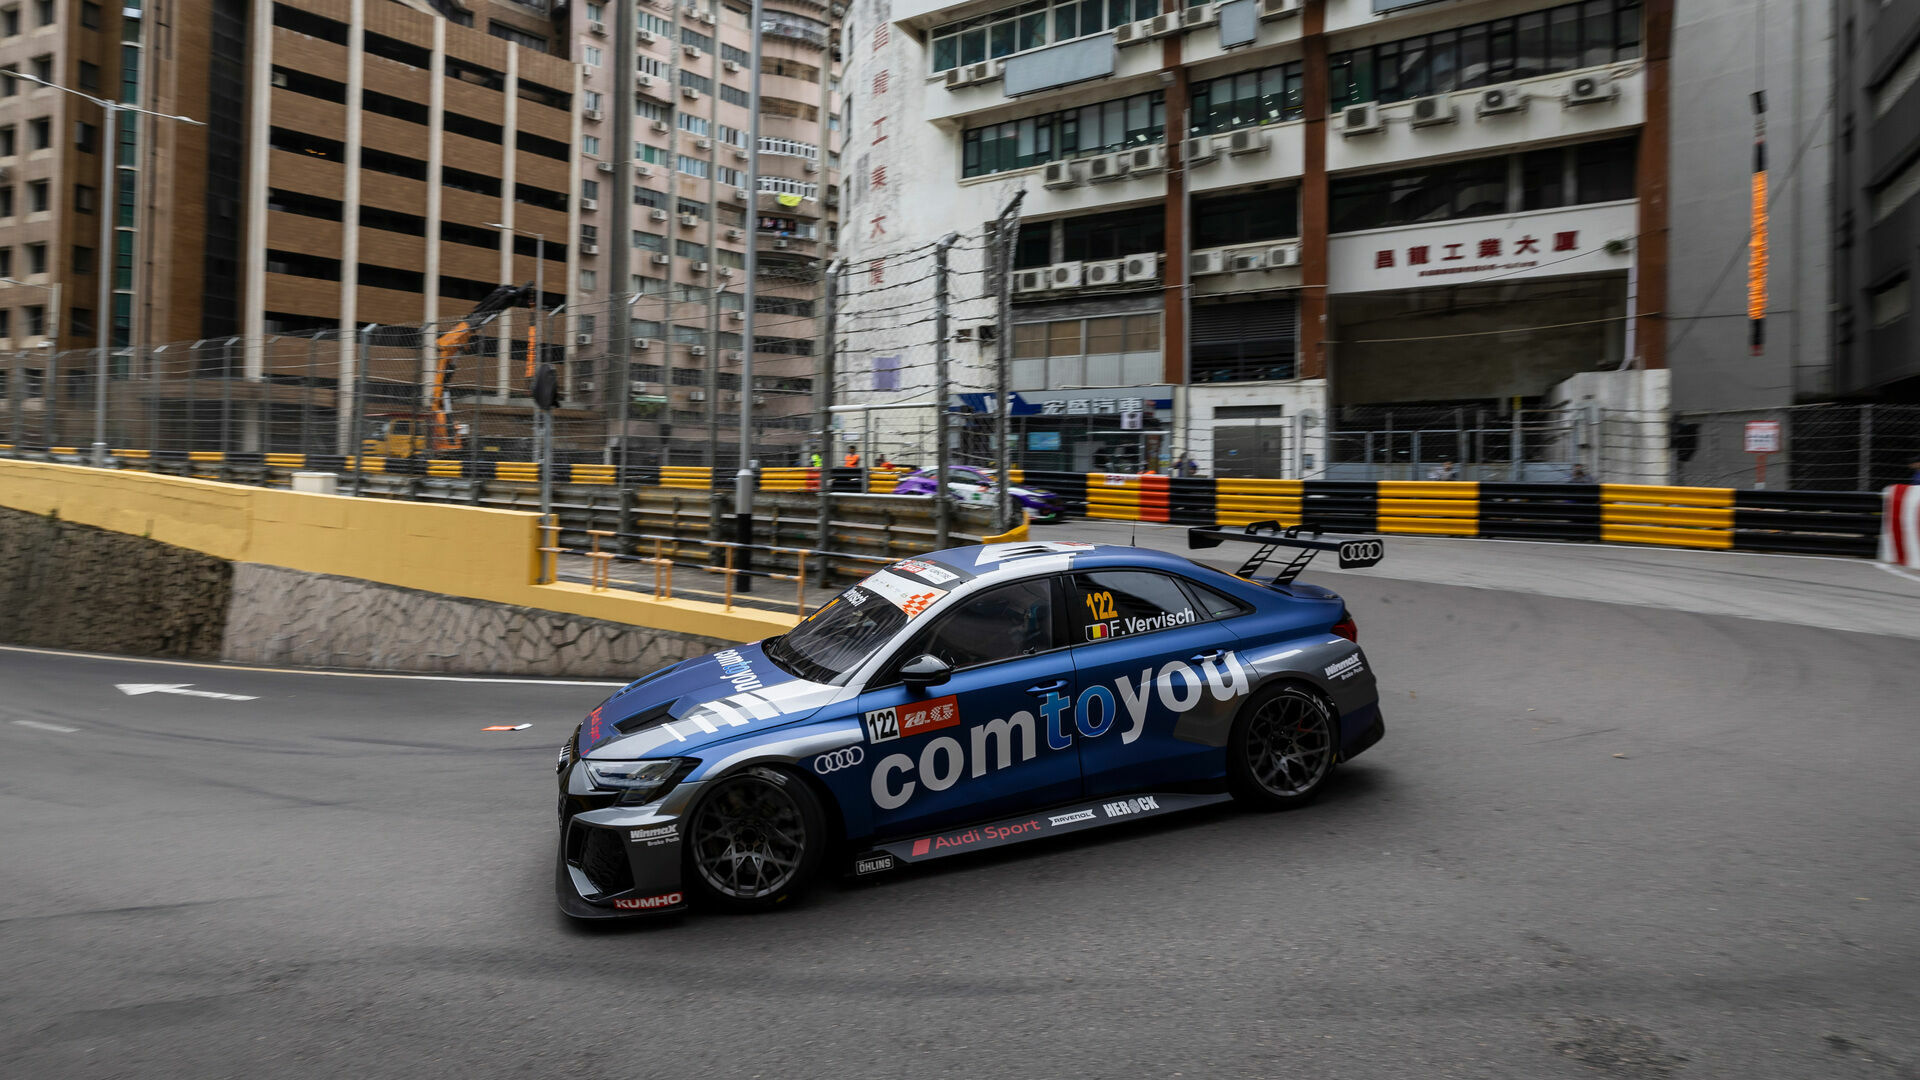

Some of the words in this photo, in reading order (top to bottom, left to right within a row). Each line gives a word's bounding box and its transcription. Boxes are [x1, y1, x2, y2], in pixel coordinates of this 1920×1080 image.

[1374, 230, 1580, 270] 昌龍工業大廈
[1086, 591, 1118, 620] 122
[869, 710, 899, 740] 122
[871, 650, 1250, 810] comtoyou
[1053, 811, 1093, 824] RAVENOL
[1102, 795, 1160, 818] HEROCK
[934, 828, 981, 849] Audi
[984, 819, 1041, 840] Sport
[858, 858, 892, 873] ÖHLINS
[615, 893, 683, 909] KUMHO
